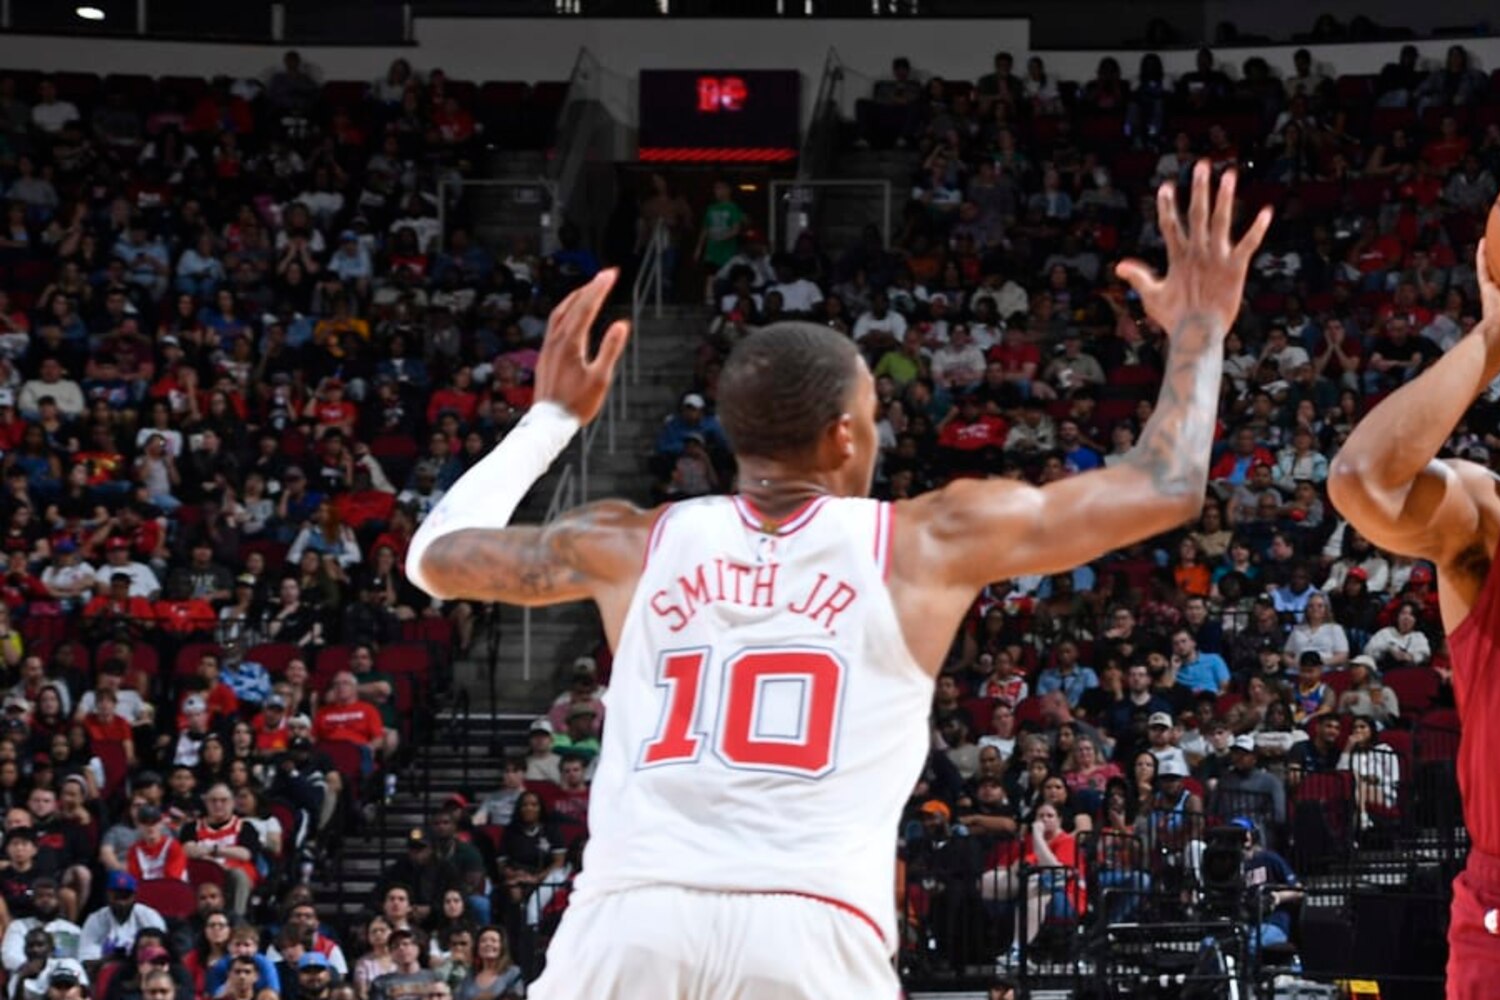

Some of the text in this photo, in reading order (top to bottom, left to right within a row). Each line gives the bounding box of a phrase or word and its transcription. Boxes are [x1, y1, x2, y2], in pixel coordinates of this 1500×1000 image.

[650, 559, 857, 637] SMITH JR.
[634, 644, 849, 781] 10
